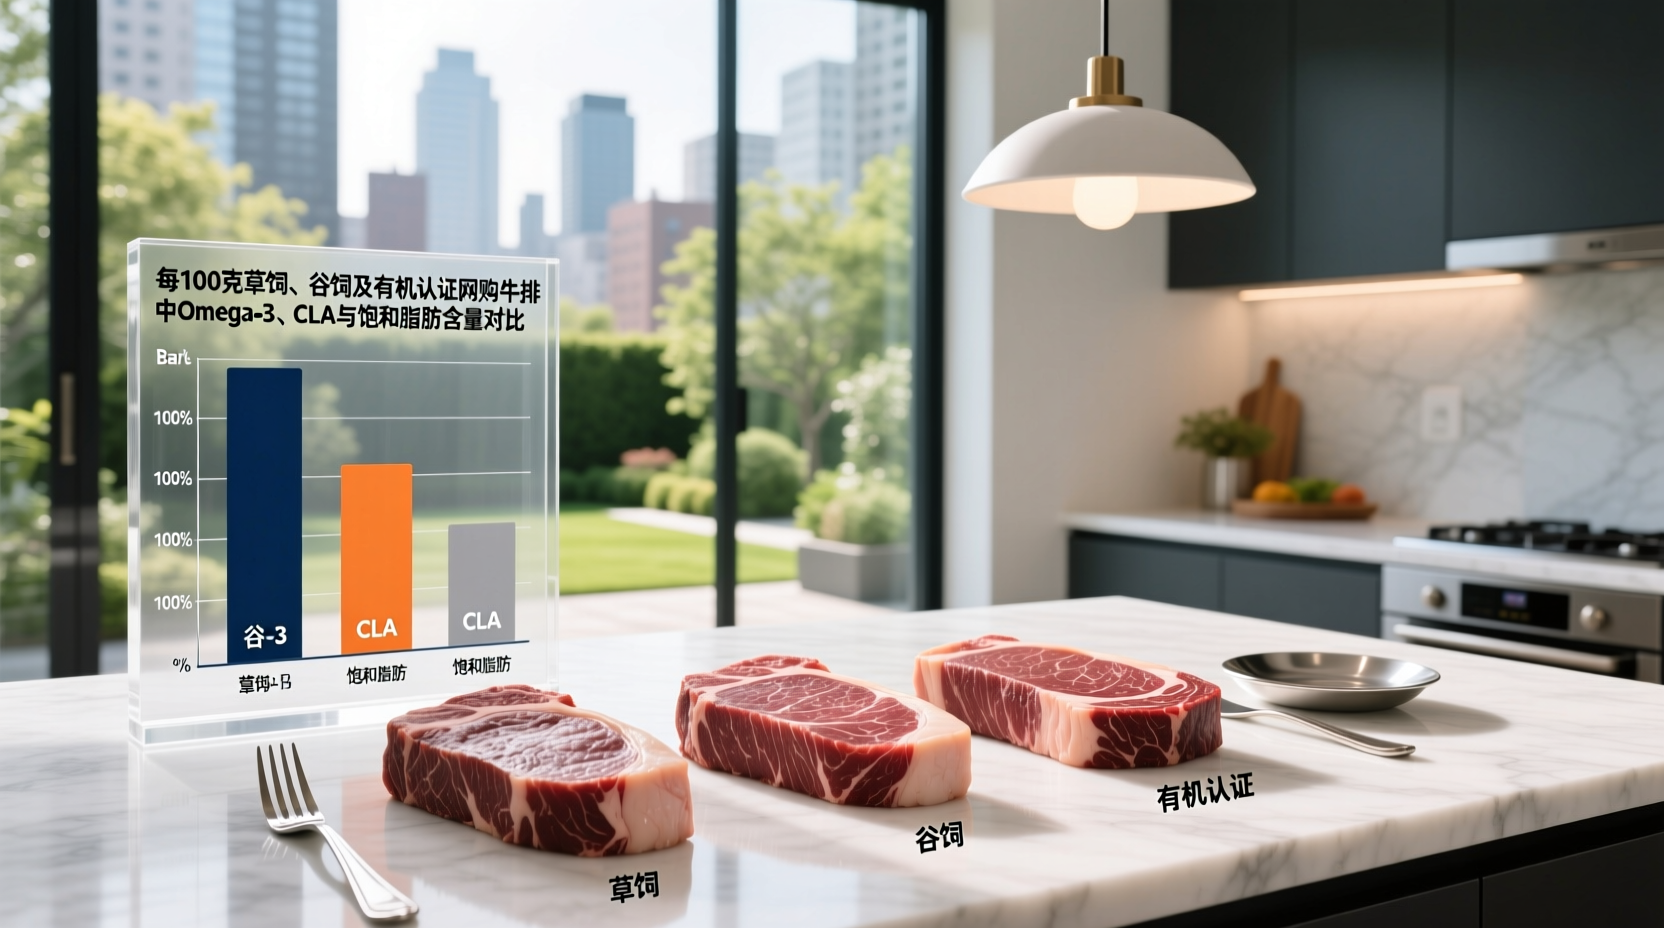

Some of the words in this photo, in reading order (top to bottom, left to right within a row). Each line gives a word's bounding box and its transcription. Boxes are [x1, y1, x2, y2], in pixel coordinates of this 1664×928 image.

[153, 410, 193, 426] 100%
[153, 470, 193, 486] 100%
[154, 531, 193, 547] 100%
[153, 594, 193, 611] 100%
[356, 618, 398, 639] CLA
[462, 611, 502, 631] CLA
[243, 624, 288, 650] 谷-3
[1157, 771, 1255, 814] 有机认证
[915, 820, 965, 854] 谷饲
[608, 870, 660, 904] 草饲
